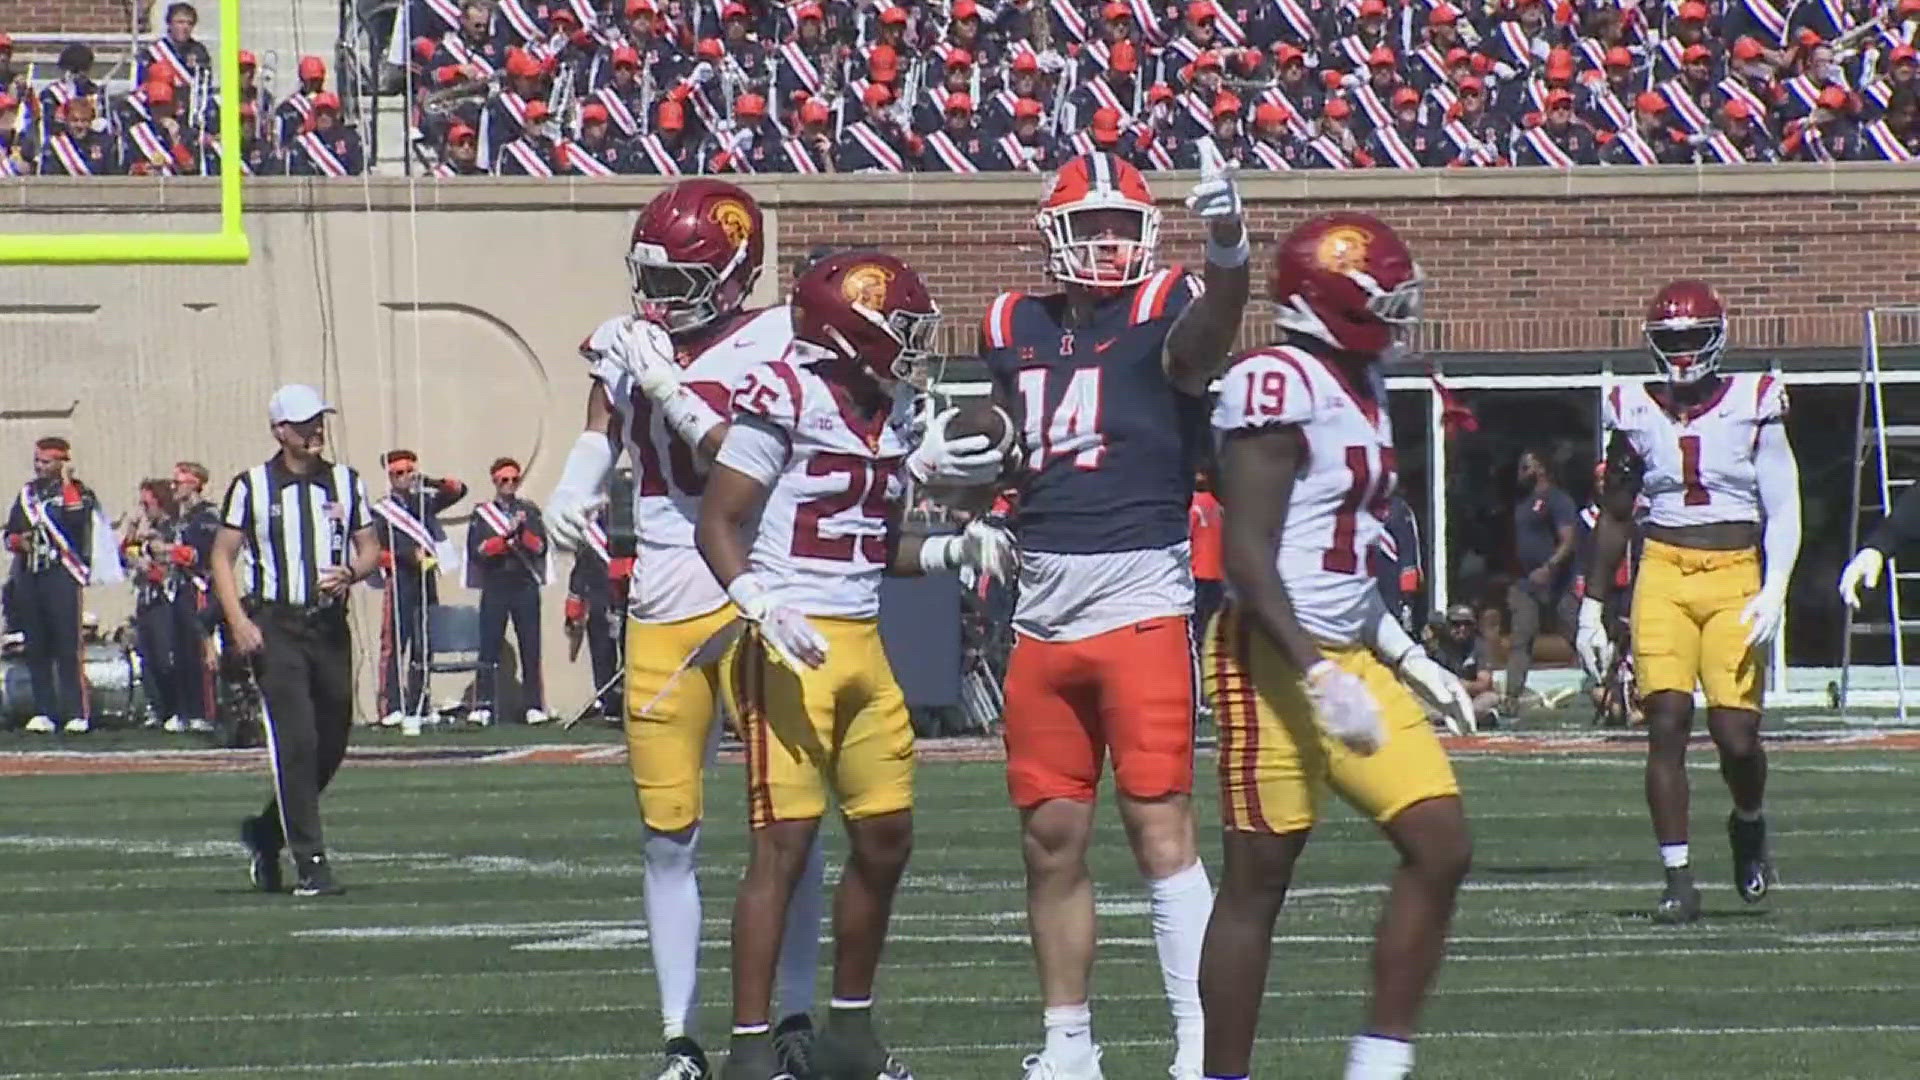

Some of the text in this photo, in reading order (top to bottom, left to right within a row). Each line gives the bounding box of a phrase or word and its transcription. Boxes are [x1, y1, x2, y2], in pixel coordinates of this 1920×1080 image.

[733, 372, 779, 417] 25
[1018, 363, 1106, 471] 14
[1244, 371, 1285, 416] 19
[1679, 435, 1711, 506] 1
